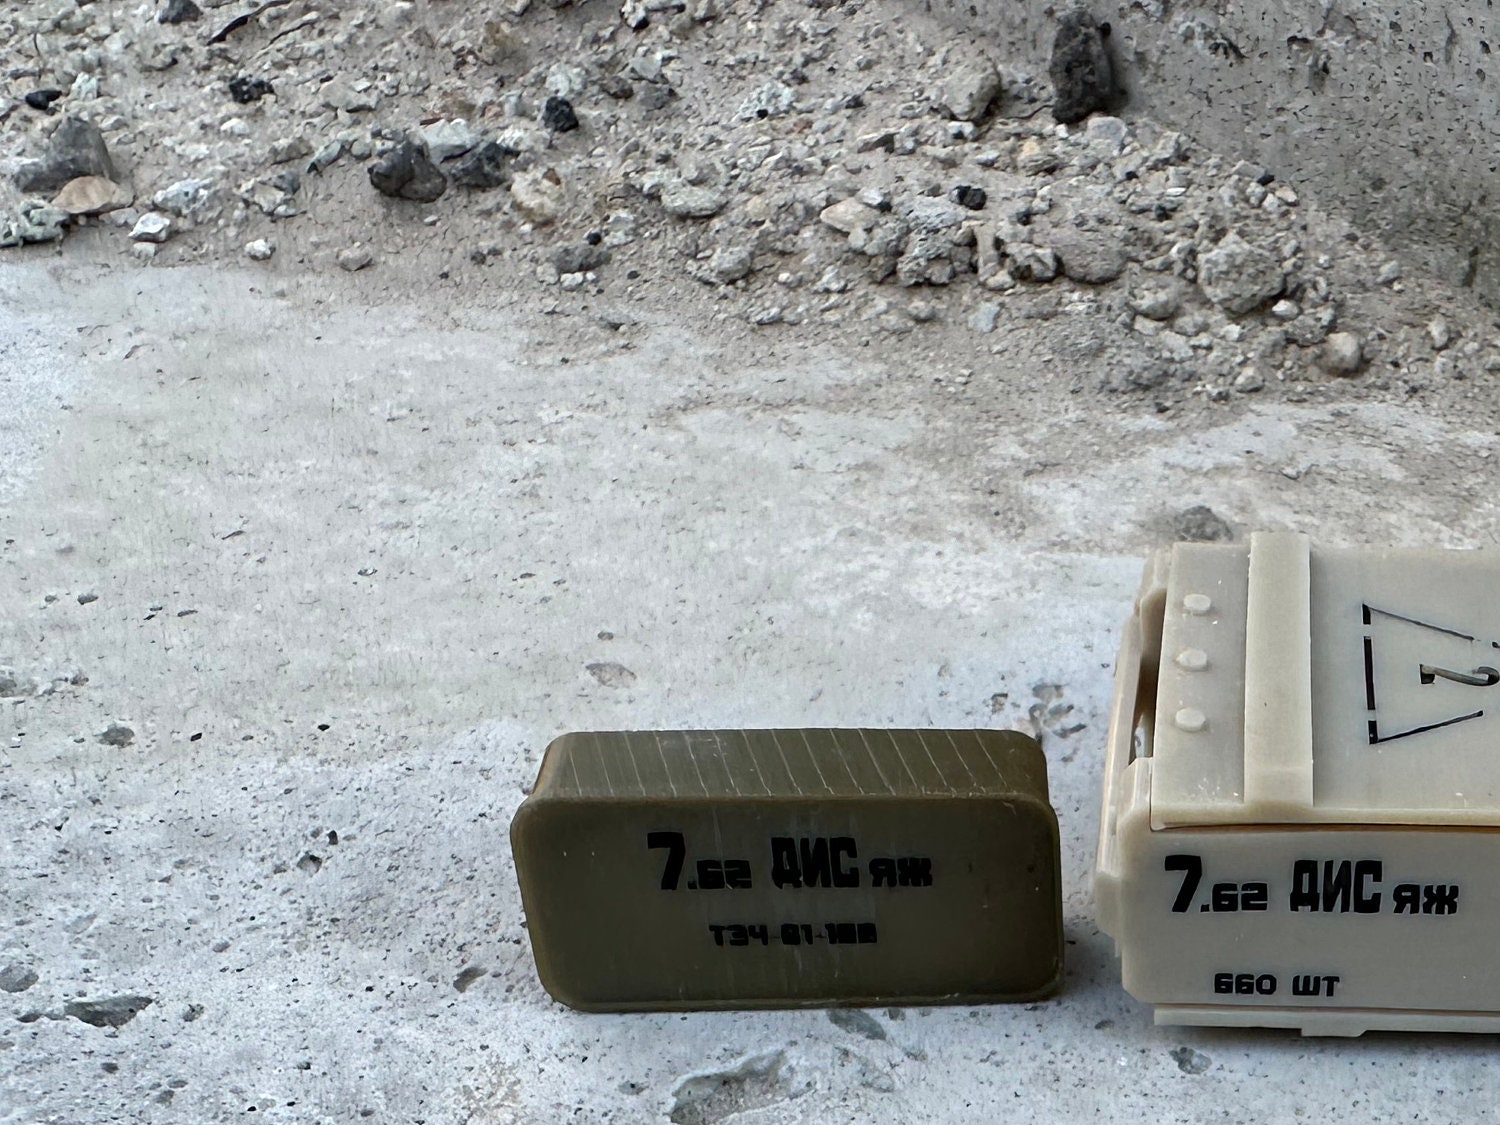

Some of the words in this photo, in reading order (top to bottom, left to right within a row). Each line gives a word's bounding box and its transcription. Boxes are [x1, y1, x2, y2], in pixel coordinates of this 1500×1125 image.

[647, 832, 752, 890] 7.62
[771, 837, 860, 889] ДИС
[1164, 854, 1268, 913] 7.62
[1290, 860, 1382, 914] ДИС
[1213, 973, 1277, 995] 660
